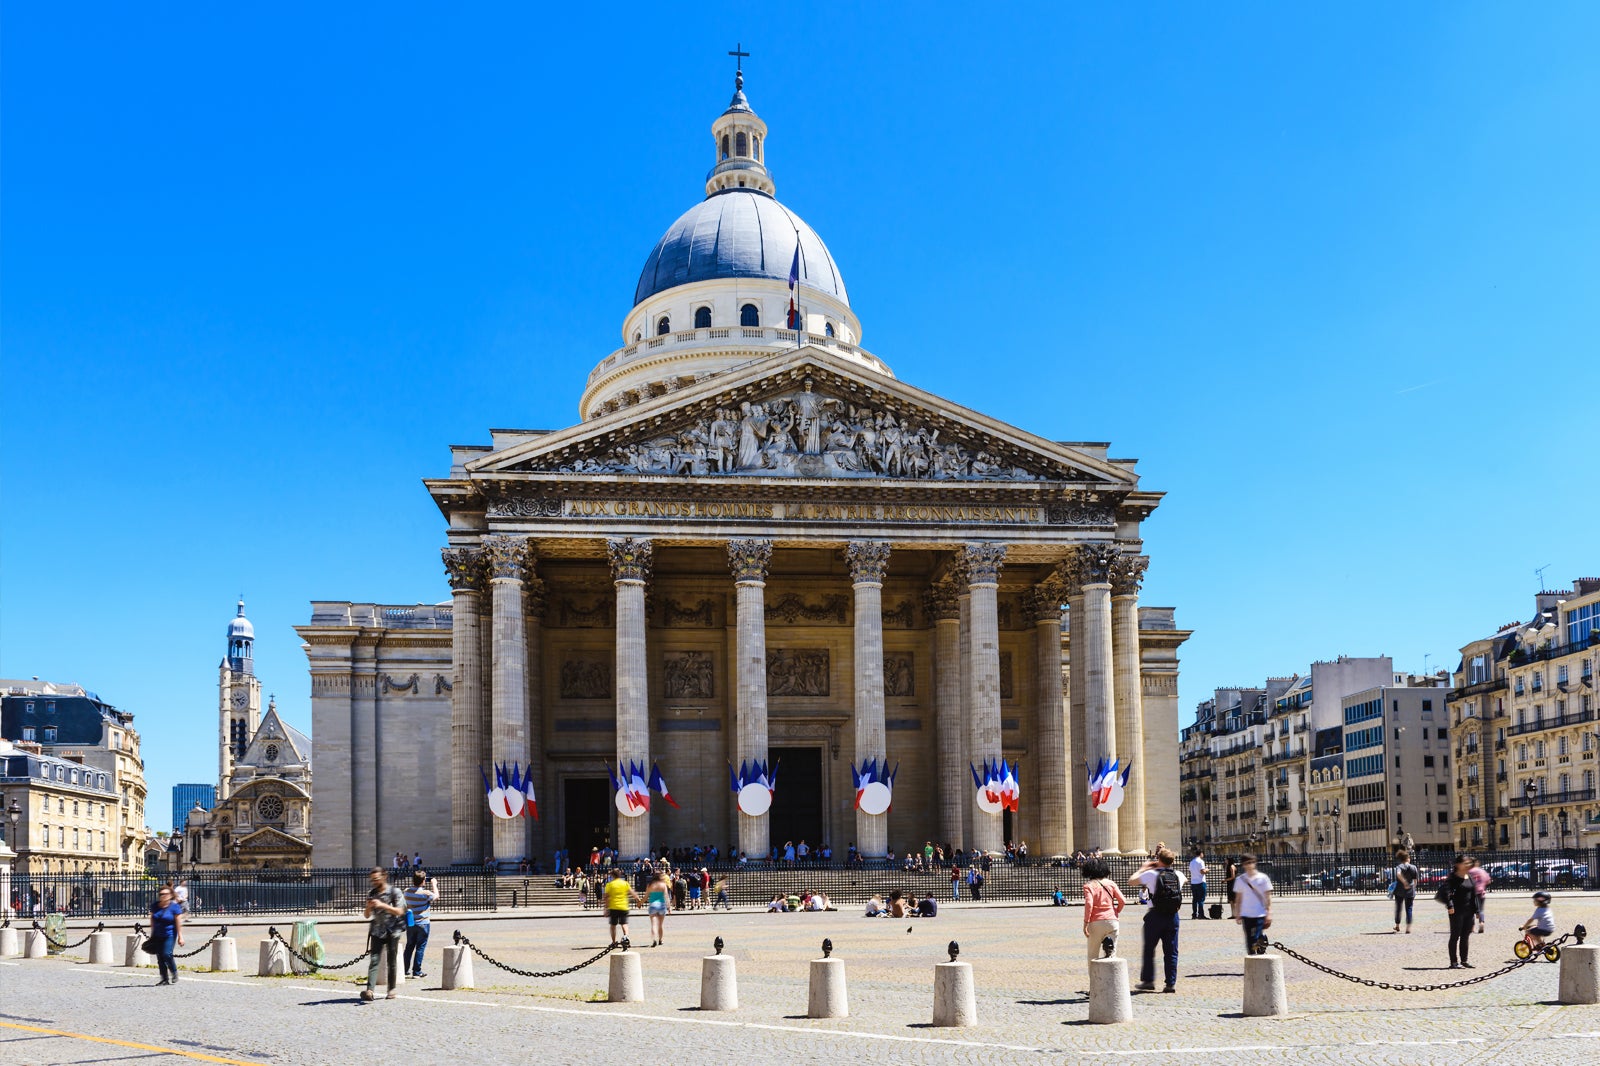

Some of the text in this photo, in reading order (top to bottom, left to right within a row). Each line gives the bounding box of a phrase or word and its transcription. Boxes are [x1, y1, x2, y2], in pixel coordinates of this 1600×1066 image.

[569, 501, 1040, 522] AUX GRANDS HOMMES LA PATRIE RECONNAISSANTE
